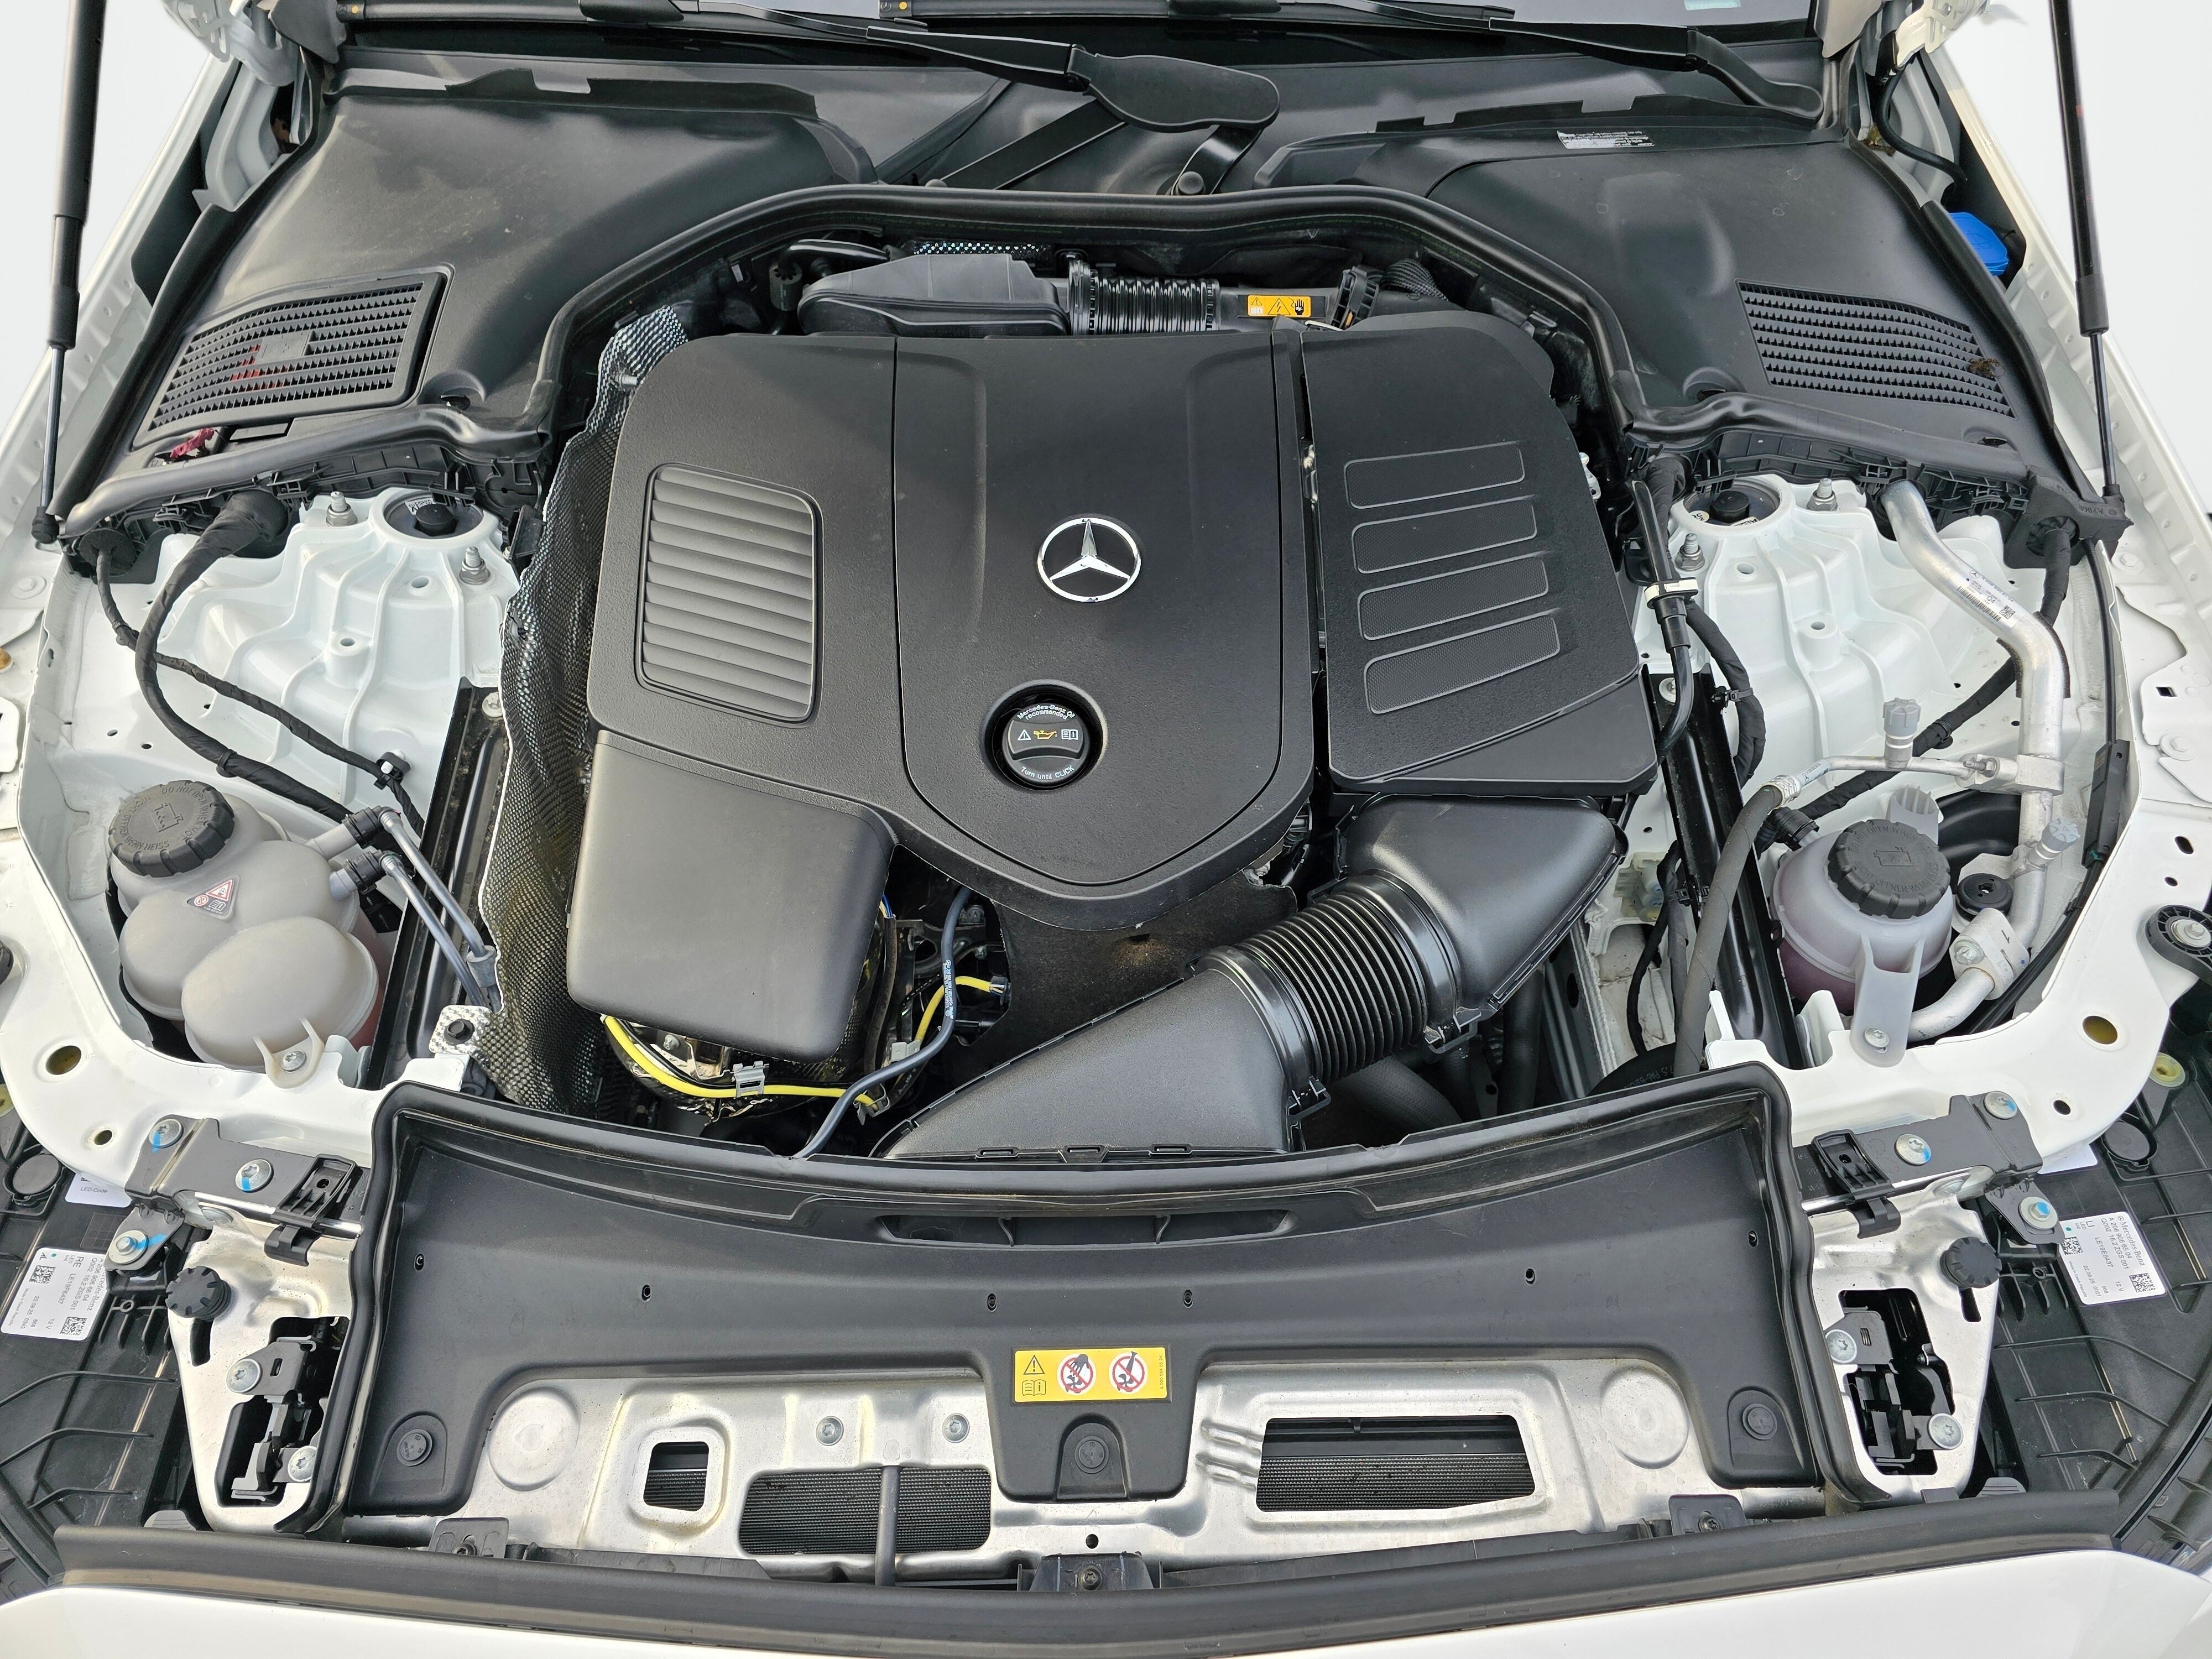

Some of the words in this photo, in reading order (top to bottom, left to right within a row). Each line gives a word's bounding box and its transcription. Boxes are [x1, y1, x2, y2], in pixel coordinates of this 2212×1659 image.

[1017, 704, 1067, 719] Mercedes-Benz
[1066, 711, 1076, 719] Oil
[1025, 709, 1068, 721] recommended
[1021, 766, 1035, 778] Turn
[1055, 765, 1075, 778] CLICK
[176, 786, 194, 795] NOT
[192, 791, 208, 806] OPEN
[1867, 826, 1890, 835] OPEN
[124, 836, 144, 851] WENN
[143, 840, 170, 851] HEISS
[2110, 1222, 2120, 1232] 206
[2115, 1233, 2125, 1243] 906
[2101, 1218, 2112, 1233] Q002
[2114, 1246, 2124, 1259] ZGS
[2120, 1259, 2129, 1269] 001
[2119, 1222, 2145, 1266] Mercedes-Benz
[2094, 1237, 2114, 1267] LE19E6437
[72, 1256, 84, 1268] RE
[86, 1257, 98, 1272] Q002
[94, 1264, 103, 1274] 206
[89, 1275, 98, 1285] 906
[58, 1273, 76, 1305] LE19F6437
[75, 1286, 85, 1300] ZGS
[2093, 1286, 2101, 1297] 0001
[70, 1300, 79, 1310] 001
